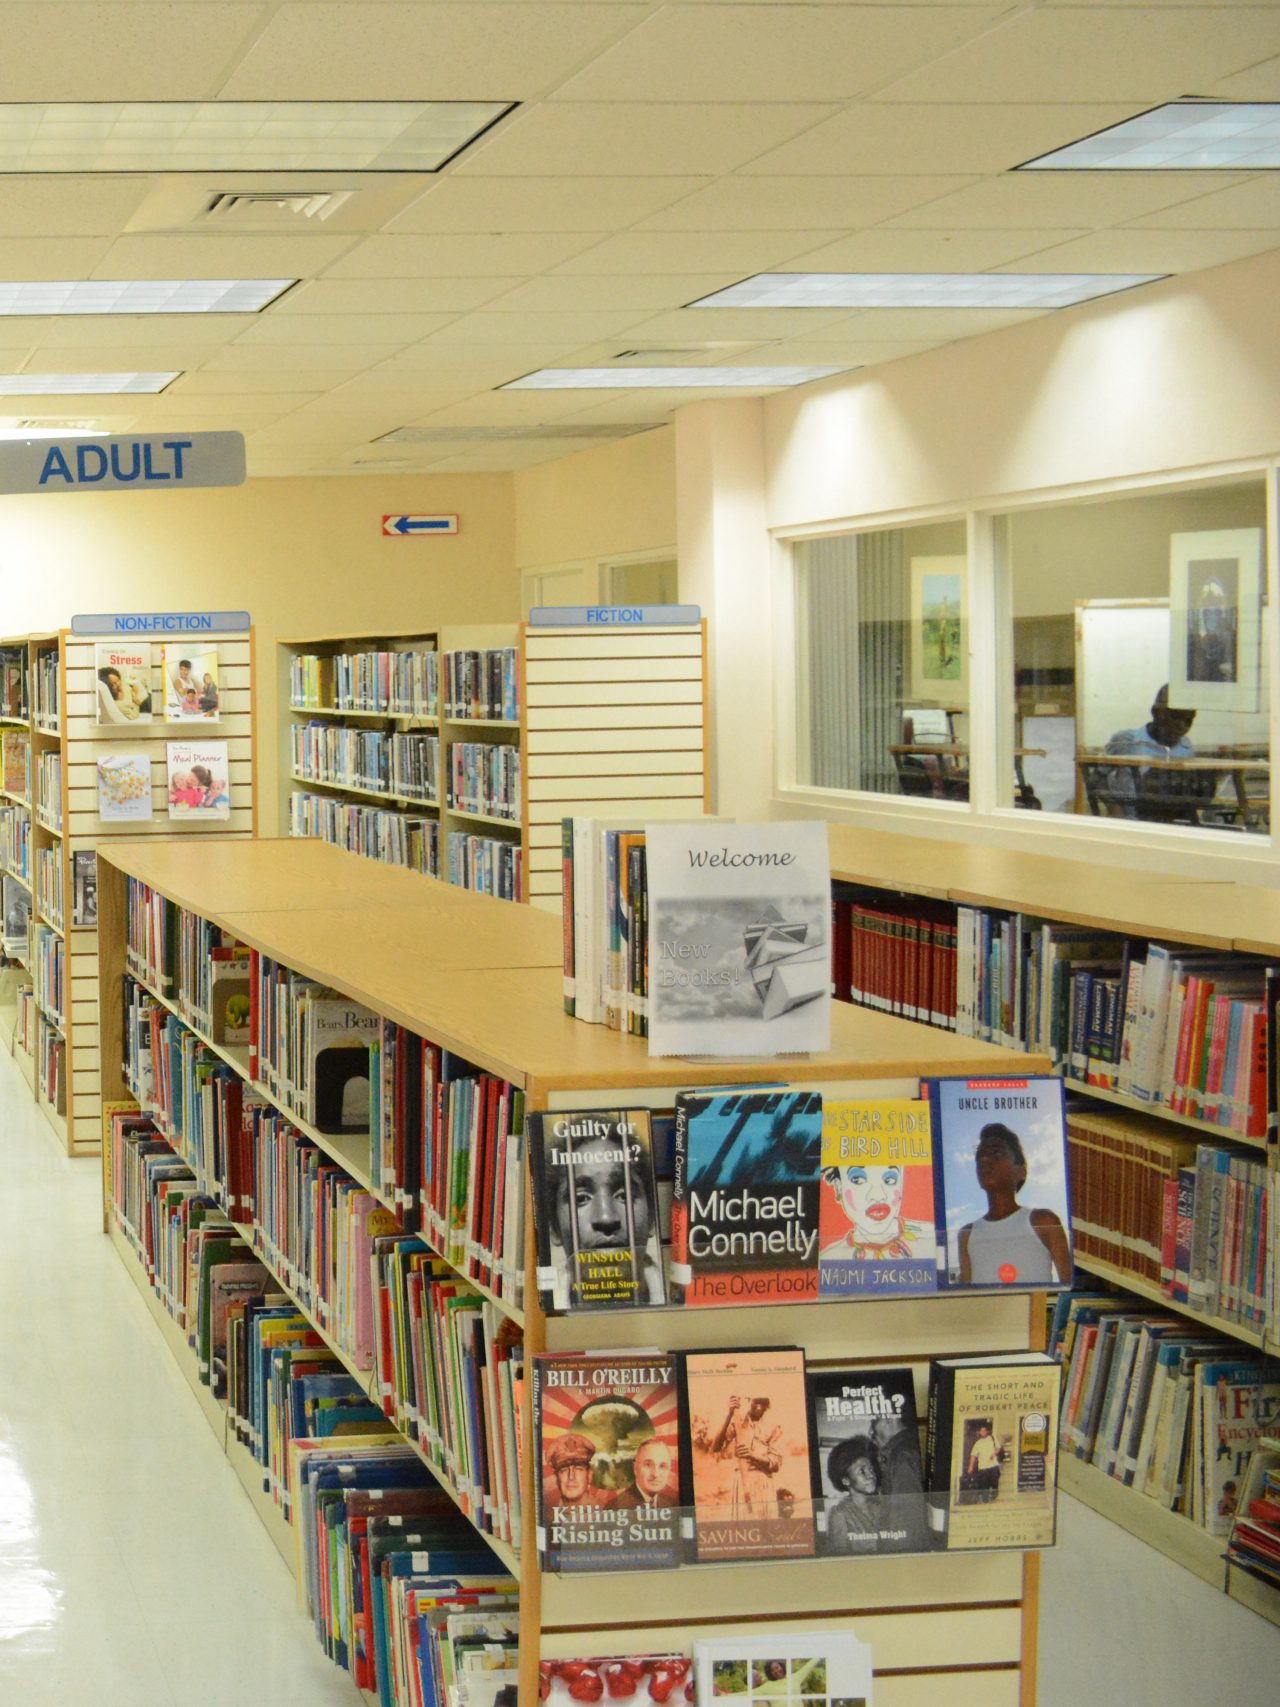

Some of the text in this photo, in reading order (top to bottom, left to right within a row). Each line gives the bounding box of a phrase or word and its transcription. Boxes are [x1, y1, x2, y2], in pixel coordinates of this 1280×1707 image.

[38, 441, 192, 485] ADULT
[115, 616, 212, 630] NON-FICTION
[586, 609, 643, 622] FICTION
[110, 655, 143, 665] Stress
[193, 753, 222, 763] Planner
[688, 848, 797, 868] Welcome
[660, 940, 712, 960] New
[660, 967, 741, 988] Books!
[959, 1096, 1038, 1110] UNCLE BROTHER
[553, 1119, 636, 1140] Guilty or
[821, 1109, 929, 1133] HE STAR SIDE
[551, 1144, 642, 1166] Innocent?
[673, 1106, 686, 1200] Michael Connelly
[840, 1136, 882, 1159] BIRD
[888, 1137, 929, 1159] HILL
[690, 1186, 806, 1223] Michael
[688, 1220, 818, 1261] Connelly
[575, 1250, 633, 1263] WINSTON
[588, 1267, 623, 1279] HALL
[821, 1268, 933, 1287] NAOMI JACKSON
[572, 1280, 640, 1291] A True Life Story
[691, 1273, 817, 1297] The Overlook
[546, 1370, 590, 1387] BILL
[592, 1367, 673, 1385] O'REILLY
[987, 1382, 1019, 1390] SHORT
[1023, 1381, 1045, 1389] AND
[842, 1385, 884, 1398] Perfect
[825, 1394, 905, 1416] Health?
[975, 1404, 1013, 1412] ROBERT
[1017, 1402, 1048, 1410] PEACE
[551, 1502, 672, 1527] Killing the
[550, 1523, 673, 1546] Rising Sun
[699, 1528, 762, 1545] SAVING
[879, 1530, 908, 1541] Wright
